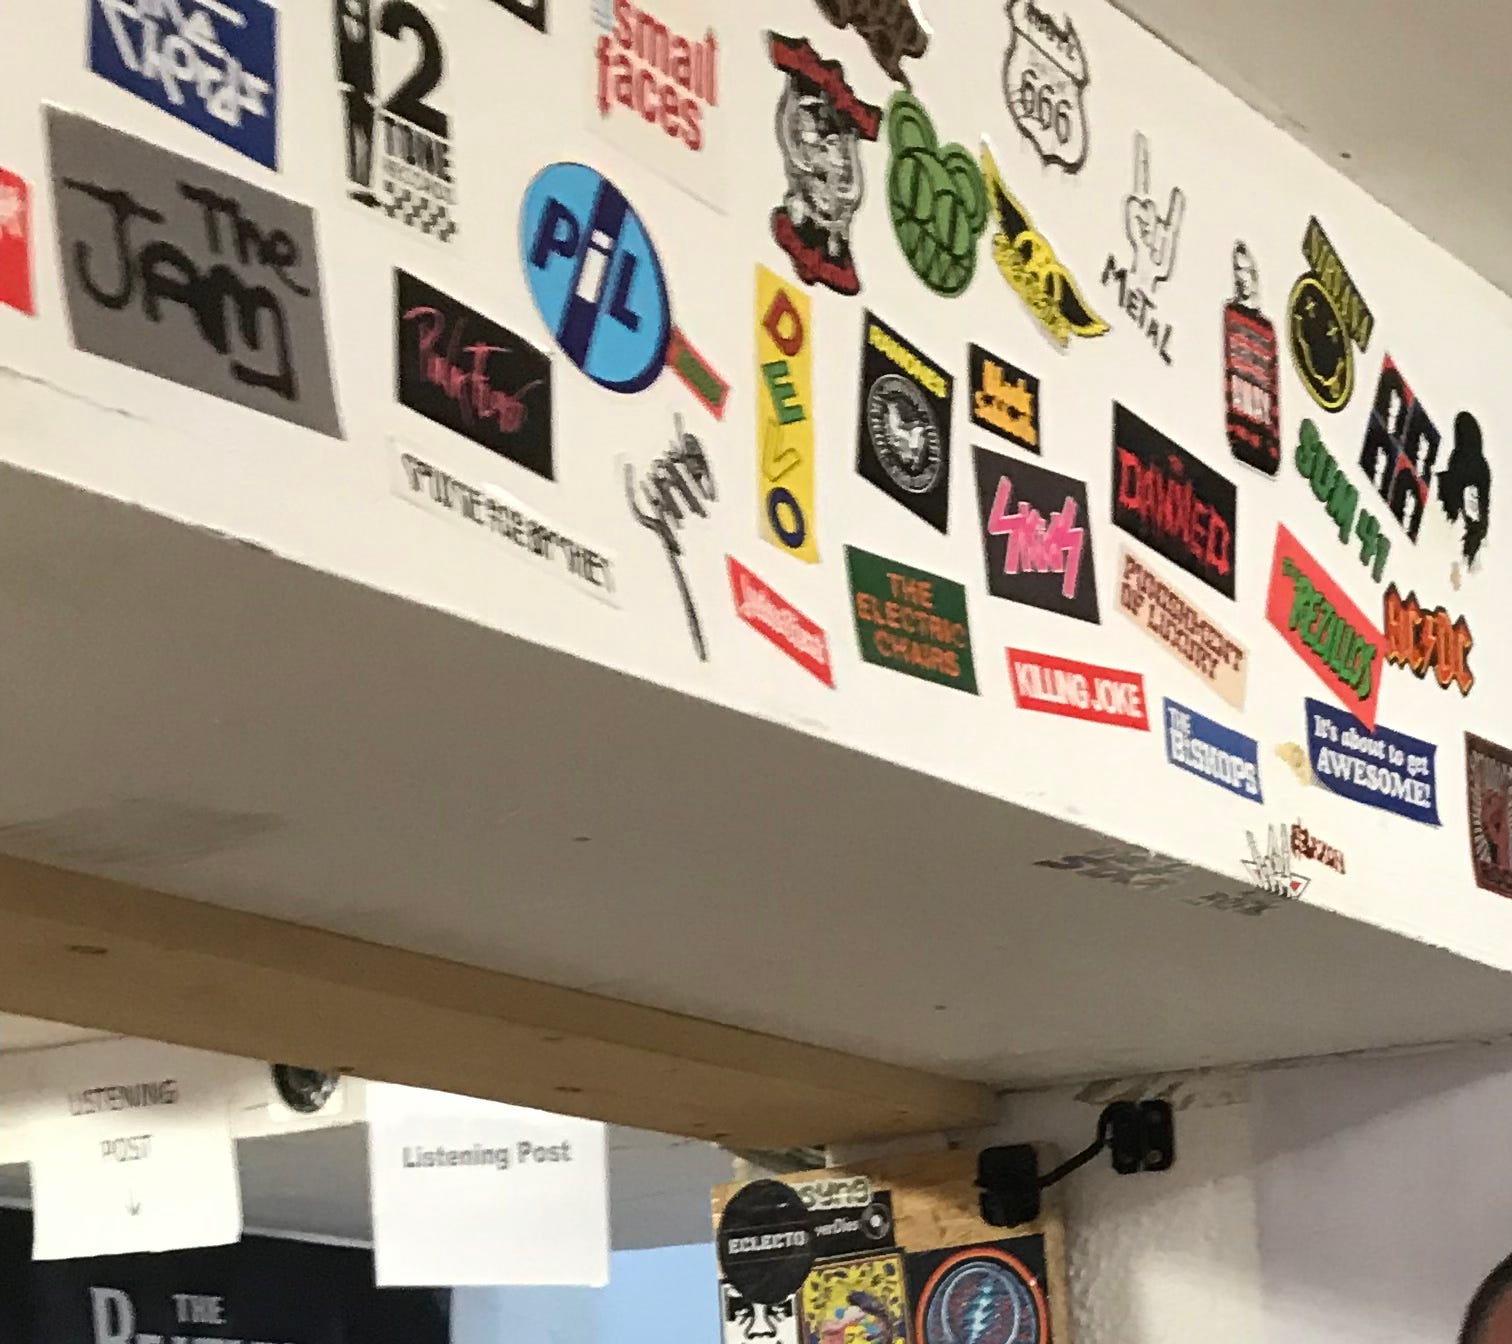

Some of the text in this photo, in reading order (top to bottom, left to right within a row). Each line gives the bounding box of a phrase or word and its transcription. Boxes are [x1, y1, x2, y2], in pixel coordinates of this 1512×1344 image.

[597, 34, 703, 152] faces
[1021, 69, 1072, 144] 666
[180, 180, 310, 296] The
[1101, 253, 1173, 366] METAL
[760, 287, 806, 549] DEVO
[887, 573, 934, 607] THE
[856, 592, 967, 650] ELECTRIC
[873, 630, 961, 677] CHAIRS
[1014, 660, 1143, 718] KILLING JOKE
[1340, 725, 1386, 761] about
[1388, 748, 1405, 768] to
[1316, 745, 1432, 808] AWESOME!
[70, 1080, 179, 1115] LISTENING
[99, 1134, 152, 1161] POST
[402, 1140, 572, 1171] Listening Post
[173, 1294, 225, 1324] THE
